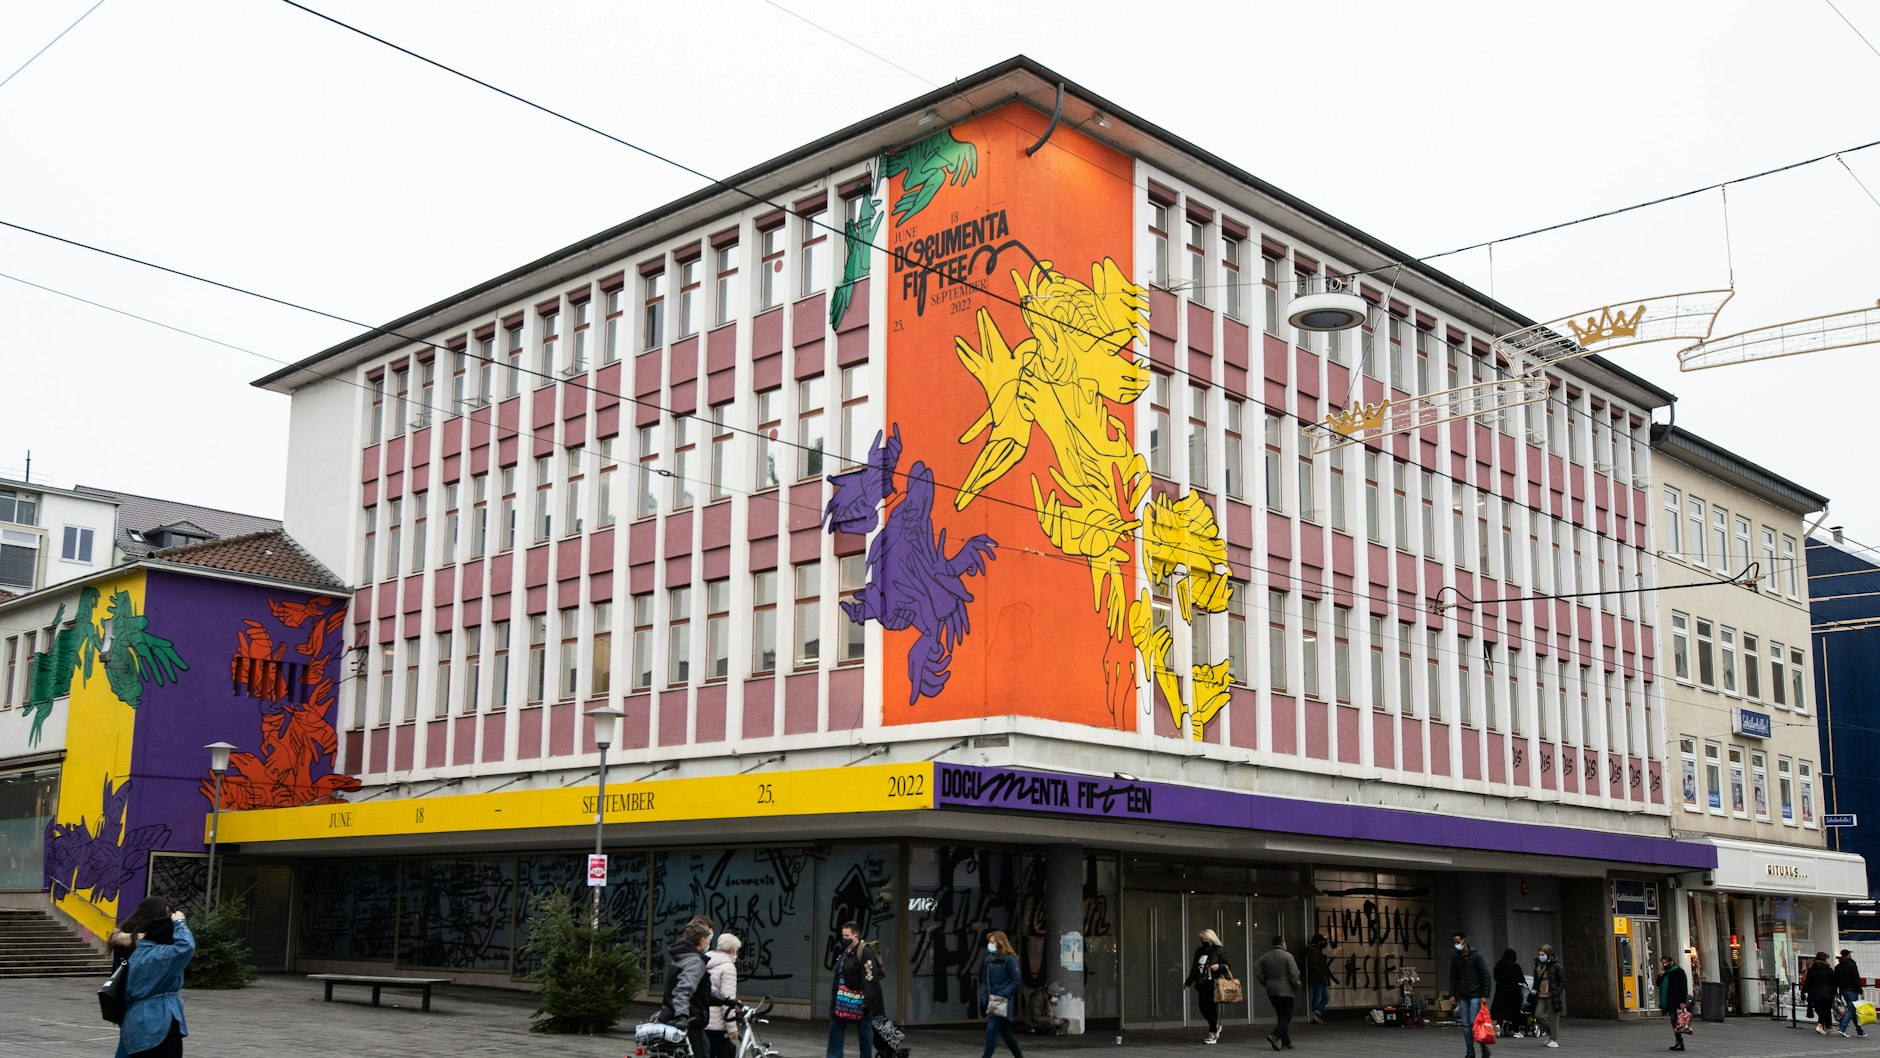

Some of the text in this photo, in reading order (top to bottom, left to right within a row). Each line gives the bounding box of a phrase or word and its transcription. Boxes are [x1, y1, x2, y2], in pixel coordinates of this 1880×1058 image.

[950, 211, 959, 224] 18
[893, 226, 918, 244] JUNE
[930, 278, 987, 307] SEPTEMBER
[950, 298, 971, 315] 2022
[329, 812, 352, 828] JUNE
[416, 807, 424, 823] 18
[757, 784, 774, 806] 25,
[888, 774, 924, 797] 2022
[725, 874, 774, 887] documenta
